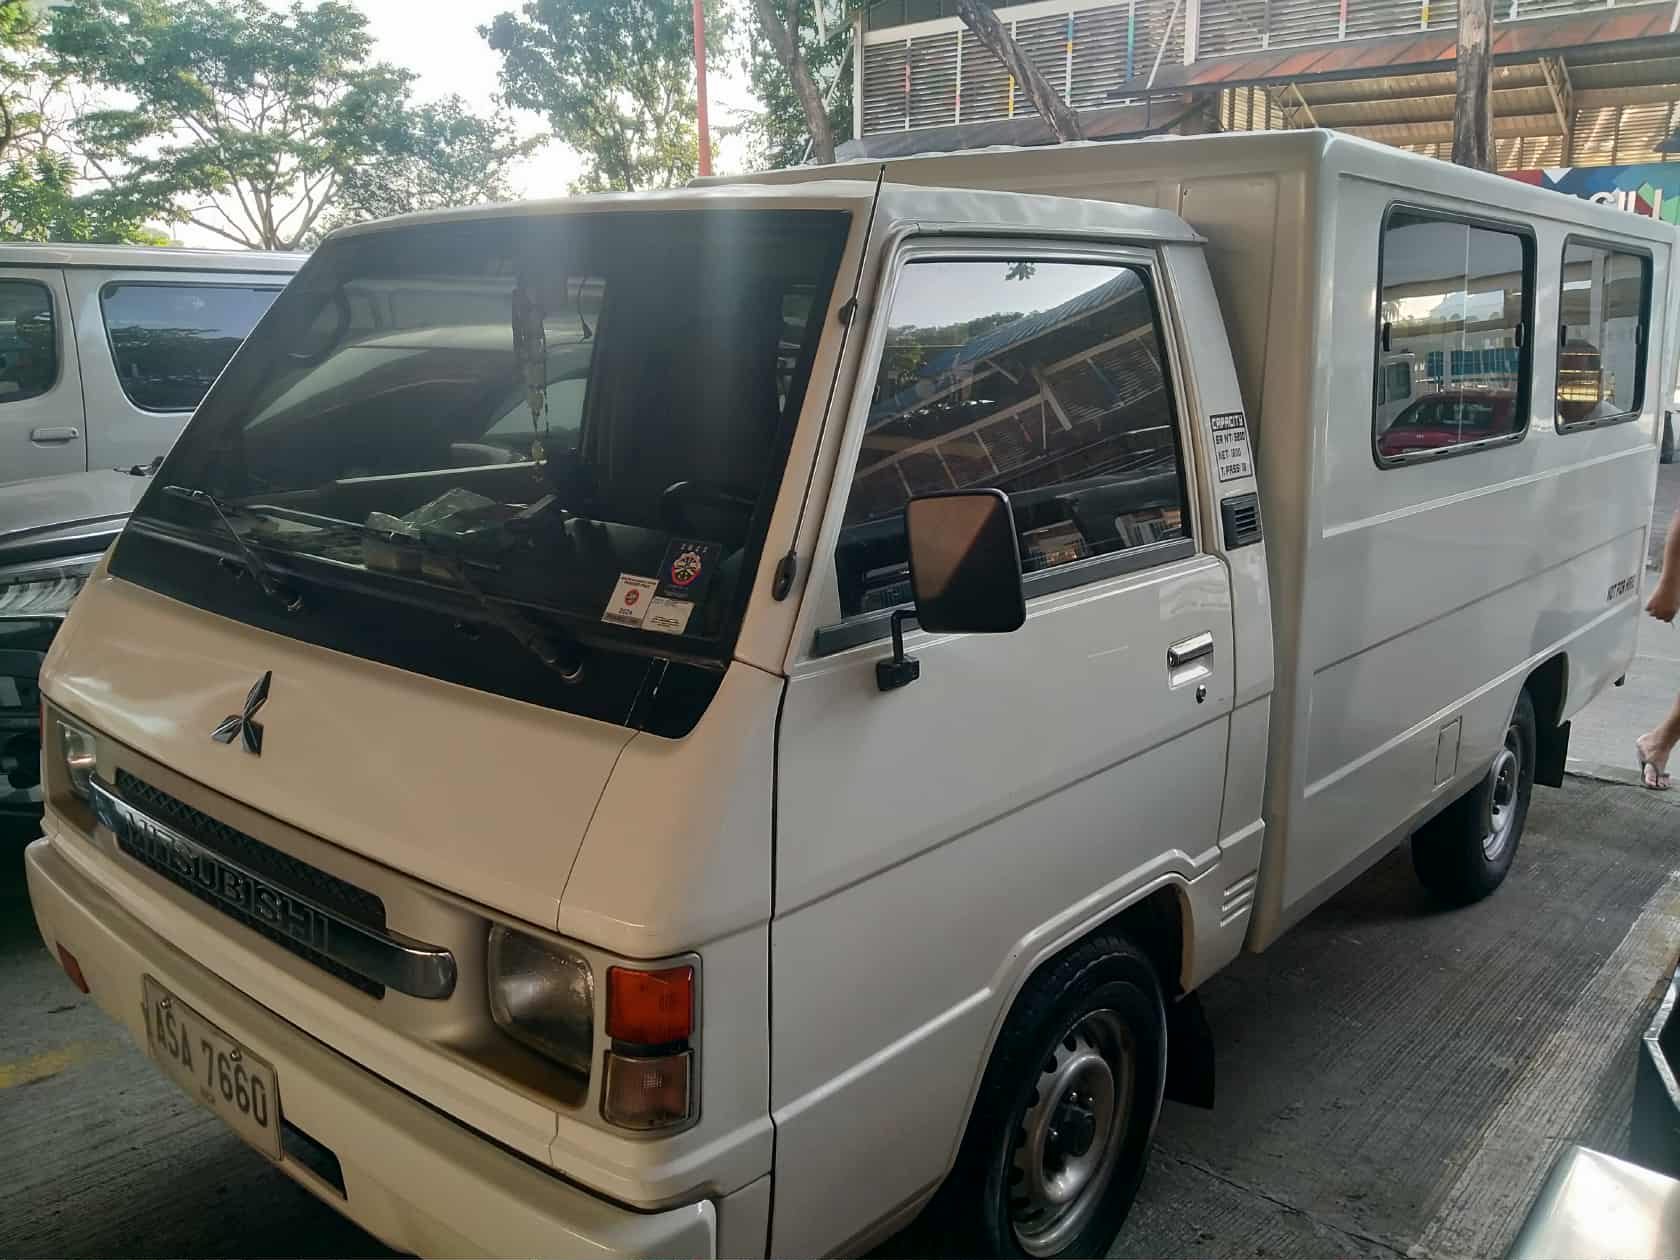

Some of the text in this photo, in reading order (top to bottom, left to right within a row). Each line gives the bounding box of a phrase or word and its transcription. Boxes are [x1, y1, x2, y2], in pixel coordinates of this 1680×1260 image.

[1212, 416, 1243, 429] CAPACITY
[125, 809, 330, 951] MITSUBISHI
[201, 1038, 268, 1128] 7660
